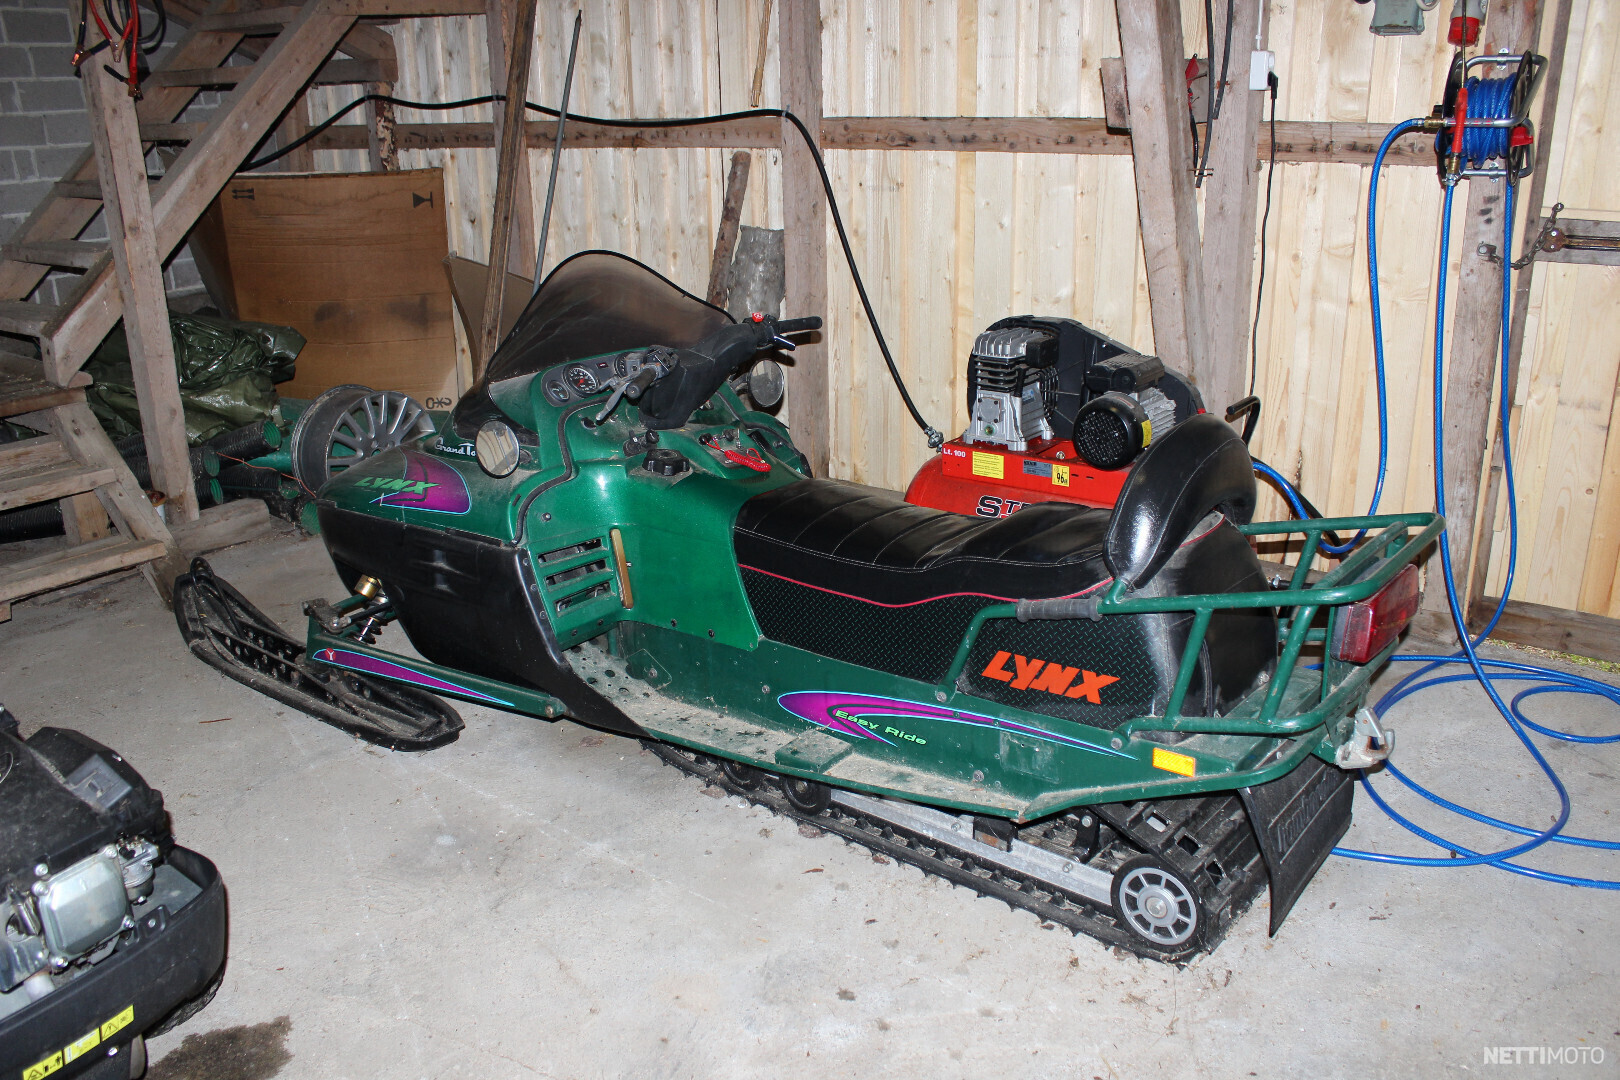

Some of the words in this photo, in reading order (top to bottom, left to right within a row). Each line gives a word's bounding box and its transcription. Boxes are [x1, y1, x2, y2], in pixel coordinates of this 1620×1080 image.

[435, 437, 465, 455] Grand
[458, 442, 477, 457] To
[953, 449, 966, 458] 100
[353, 477, 443, 495] LYNX
[981, 650, 1121, 705] LYNX
[834, 709, 880, 730] Easy
[884, 726, 927, 746] Ride
